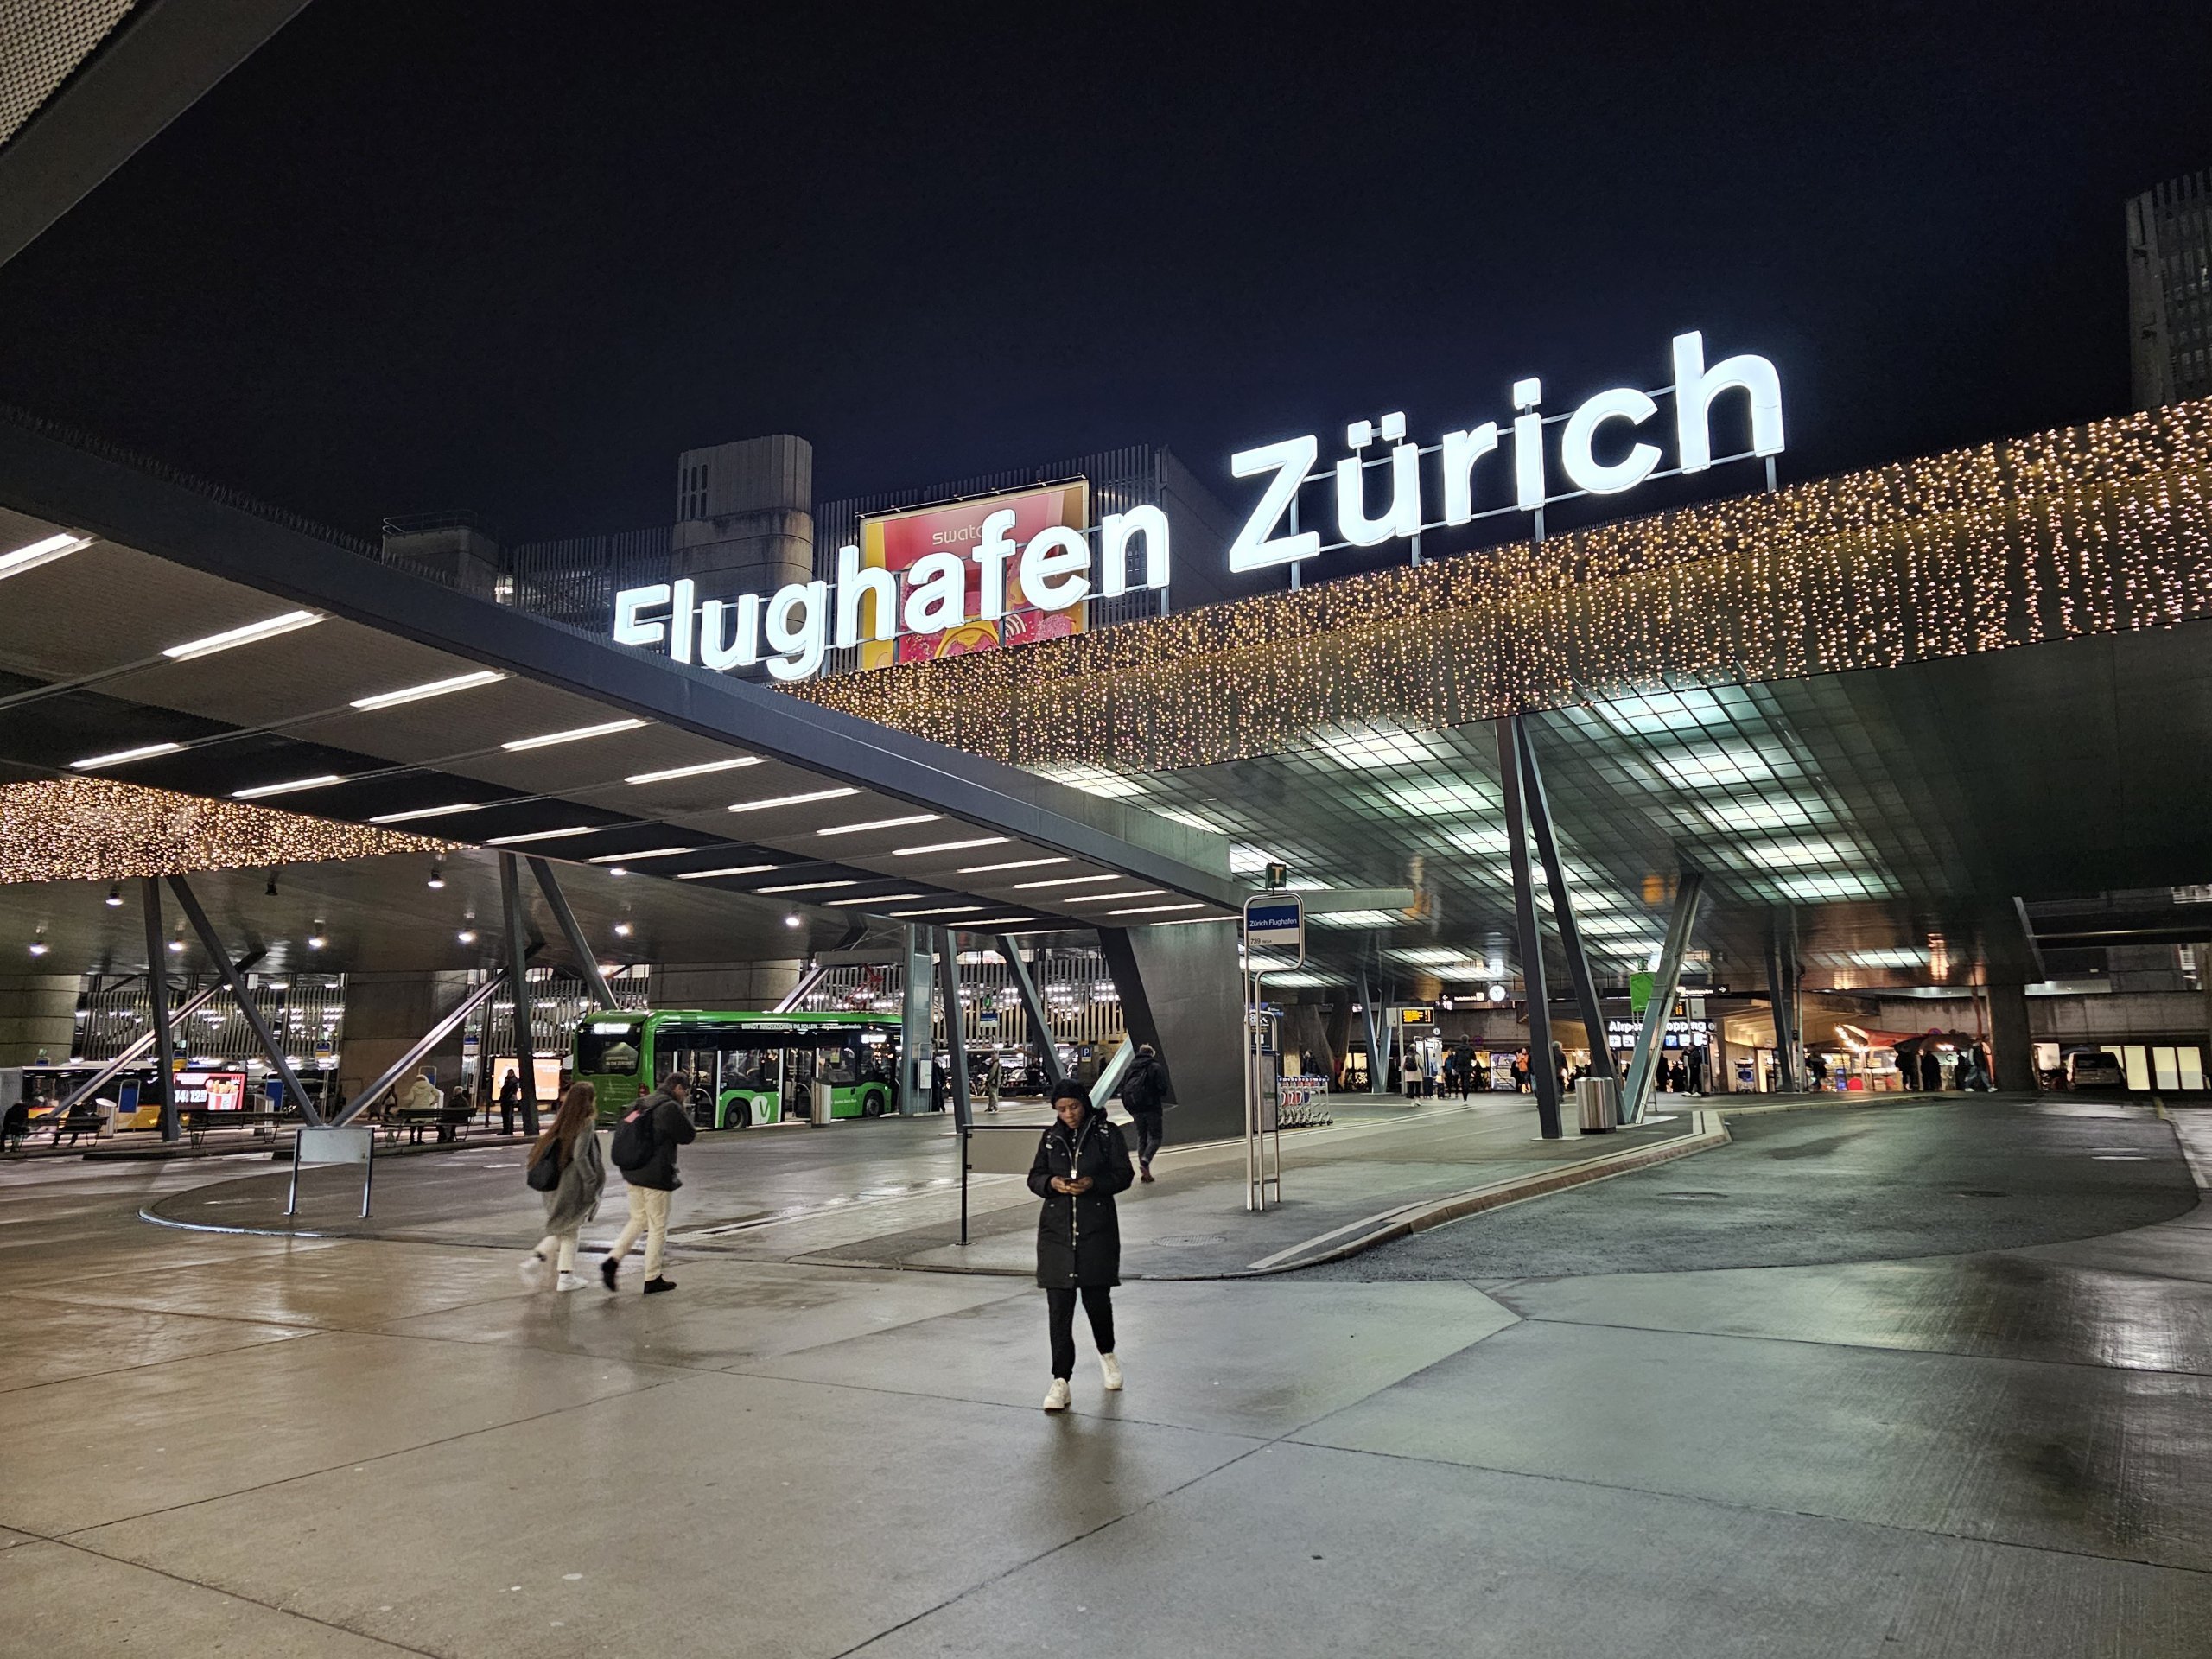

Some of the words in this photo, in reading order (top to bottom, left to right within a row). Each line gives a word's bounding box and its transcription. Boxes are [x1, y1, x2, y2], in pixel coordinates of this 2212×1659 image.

[613, 504, 1170, 681] Flughafen
[1229, 329, 1785, 573] Zürich
[932, 524, 983, 545] swatc
[1272, 866, 1284, 884] T
[1268, 918, 1297, 926] Flughafen
